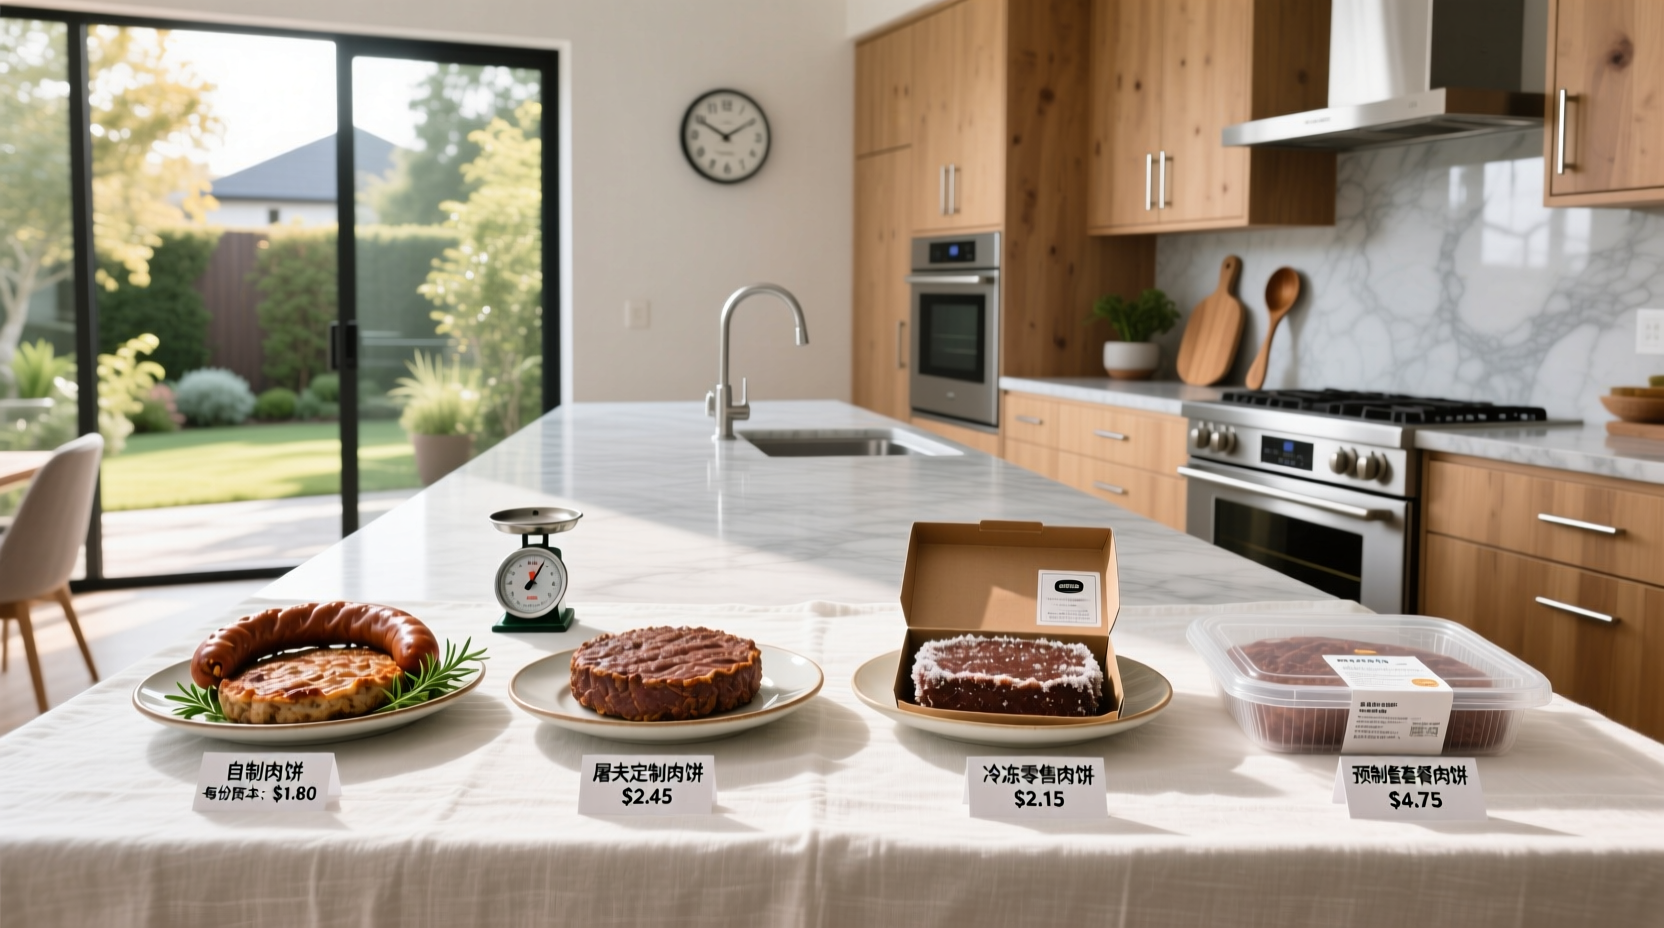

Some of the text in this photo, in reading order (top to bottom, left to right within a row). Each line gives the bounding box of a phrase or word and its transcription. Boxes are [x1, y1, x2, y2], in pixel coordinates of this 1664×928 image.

[228, 760, 304, 783] 自制肉饼
[593, 762, 704, 783] 屠夫定制肉饼
[983, 763, 1095, 785] 冷冻零售肉饼
[272, 784, 317, 803] $1.80
[621, 787, 673, 807] $2.45
[1014, 789, 1065, 809] $2.15
[1388, 790, 1443, 810] $4.75
